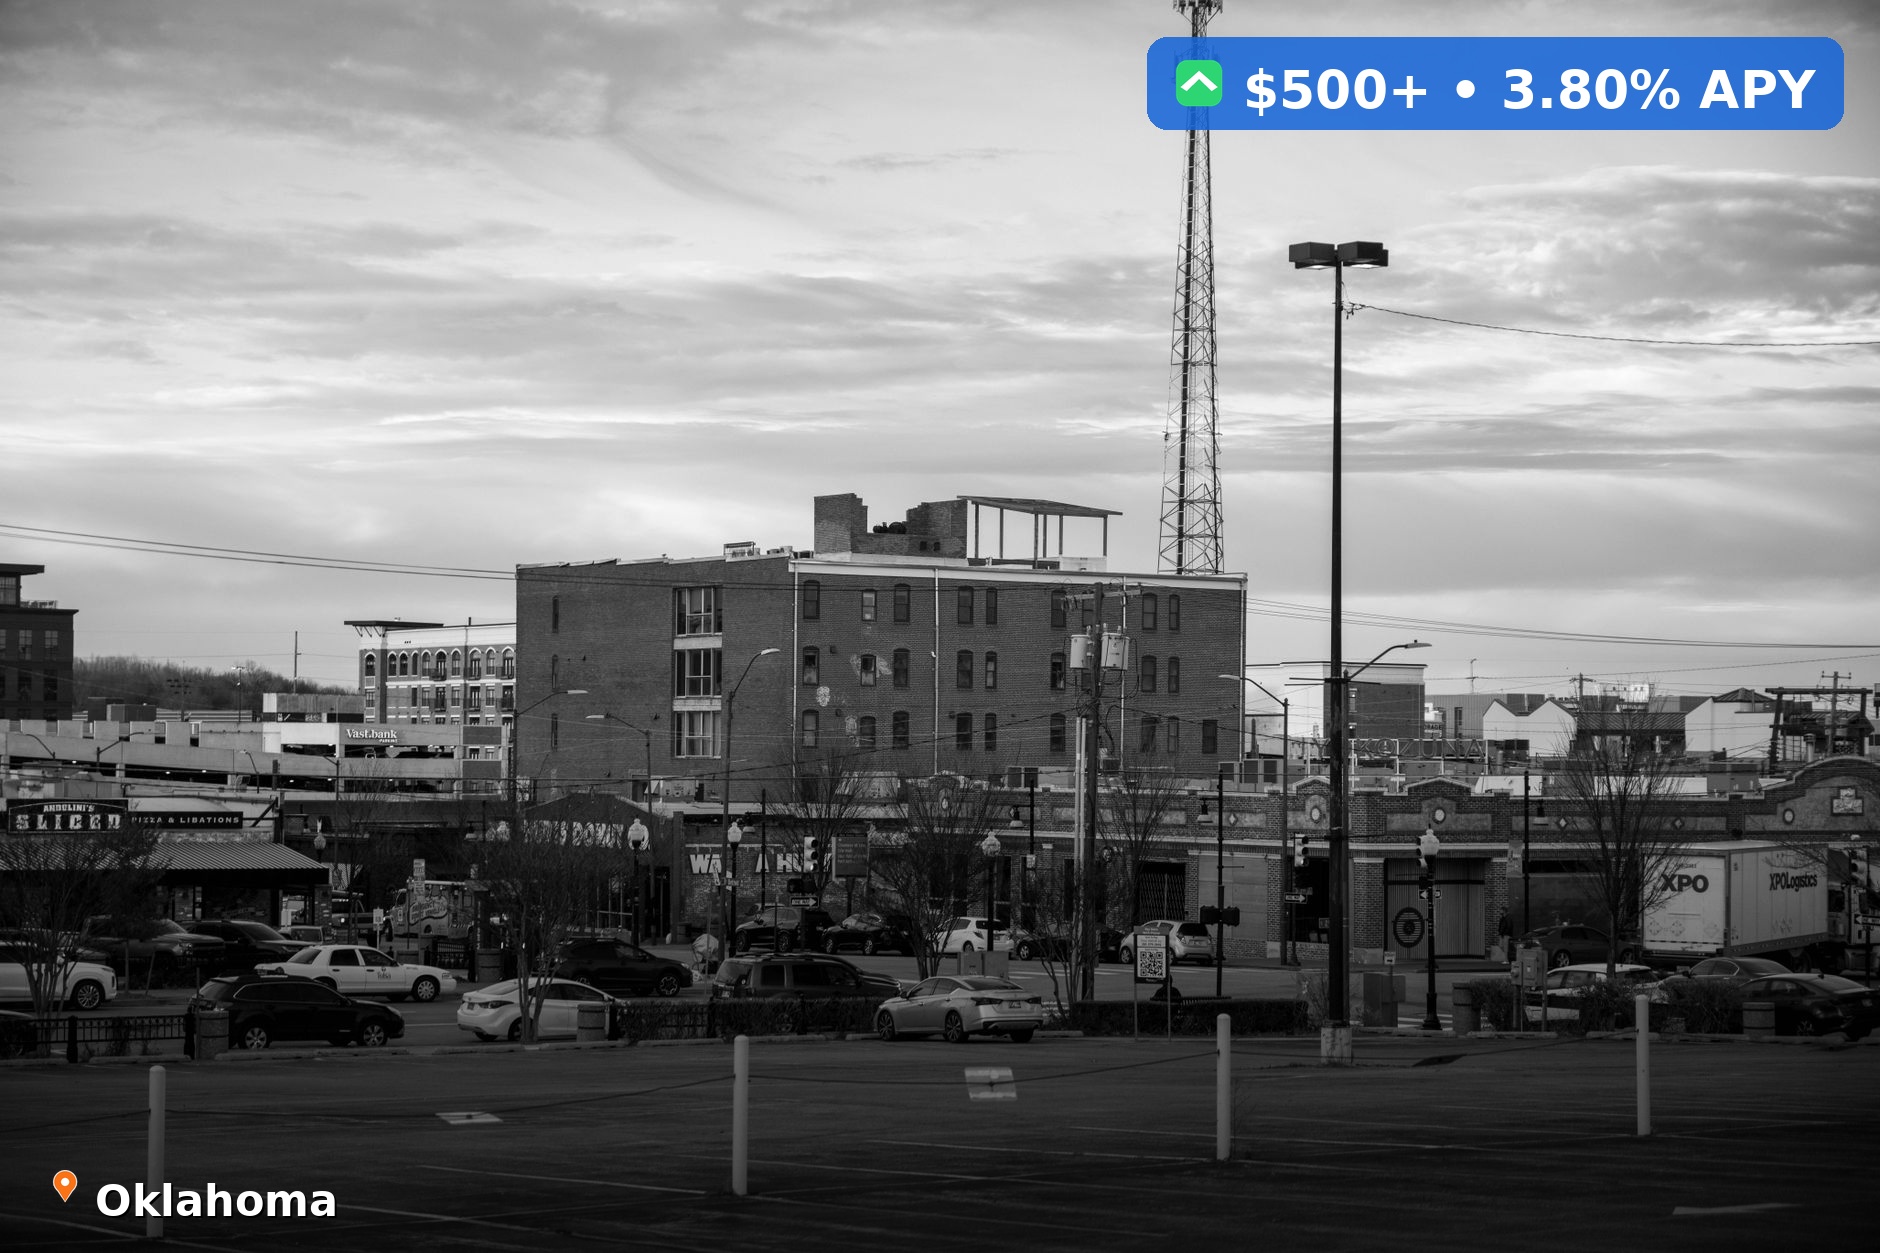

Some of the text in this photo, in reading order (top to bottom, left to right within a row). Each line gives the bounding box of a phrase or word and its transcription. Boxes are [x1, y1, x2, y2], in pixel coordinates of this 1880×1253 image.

[1311, 738, 1486, 760] YKOZUNA
[15, 814, 121, 831] SLICED
[131, 816, 240, 824] PIZZA & LIBATIONS
[1661, 873, 1709, 893] XPO
